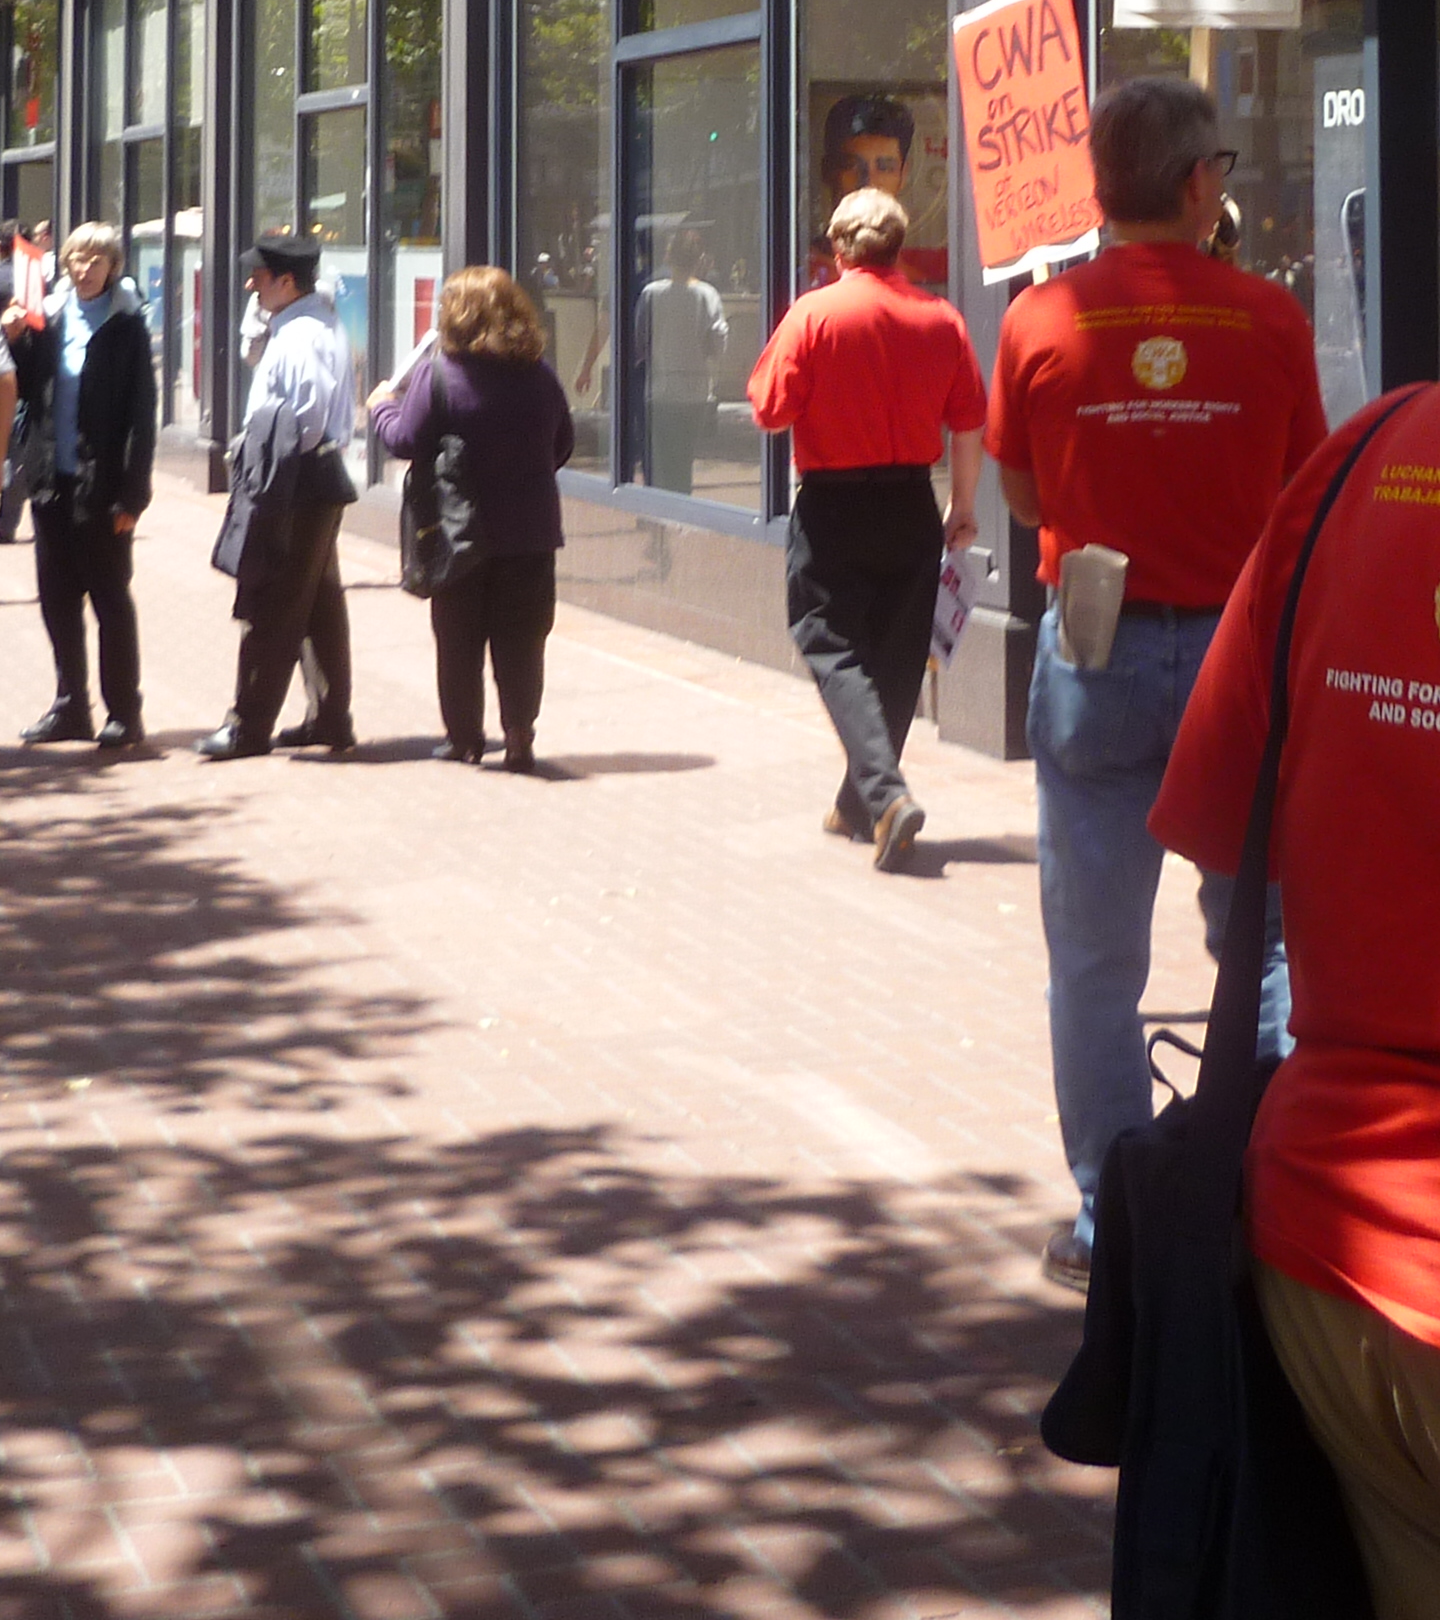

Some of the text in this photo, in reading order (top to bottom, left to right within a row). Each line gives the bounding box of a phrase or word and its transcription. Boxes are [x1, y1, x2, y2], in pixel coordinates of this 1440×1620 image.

[978, 85, 1091, 171] STRIKE
[985, 164, 1061, 231] VERIZON
[1011, 196, 1105, 253] WIRELESS
[1326, 667, 1403, 699] FIGHTING
[1369, 700, 1406, 725] AND
